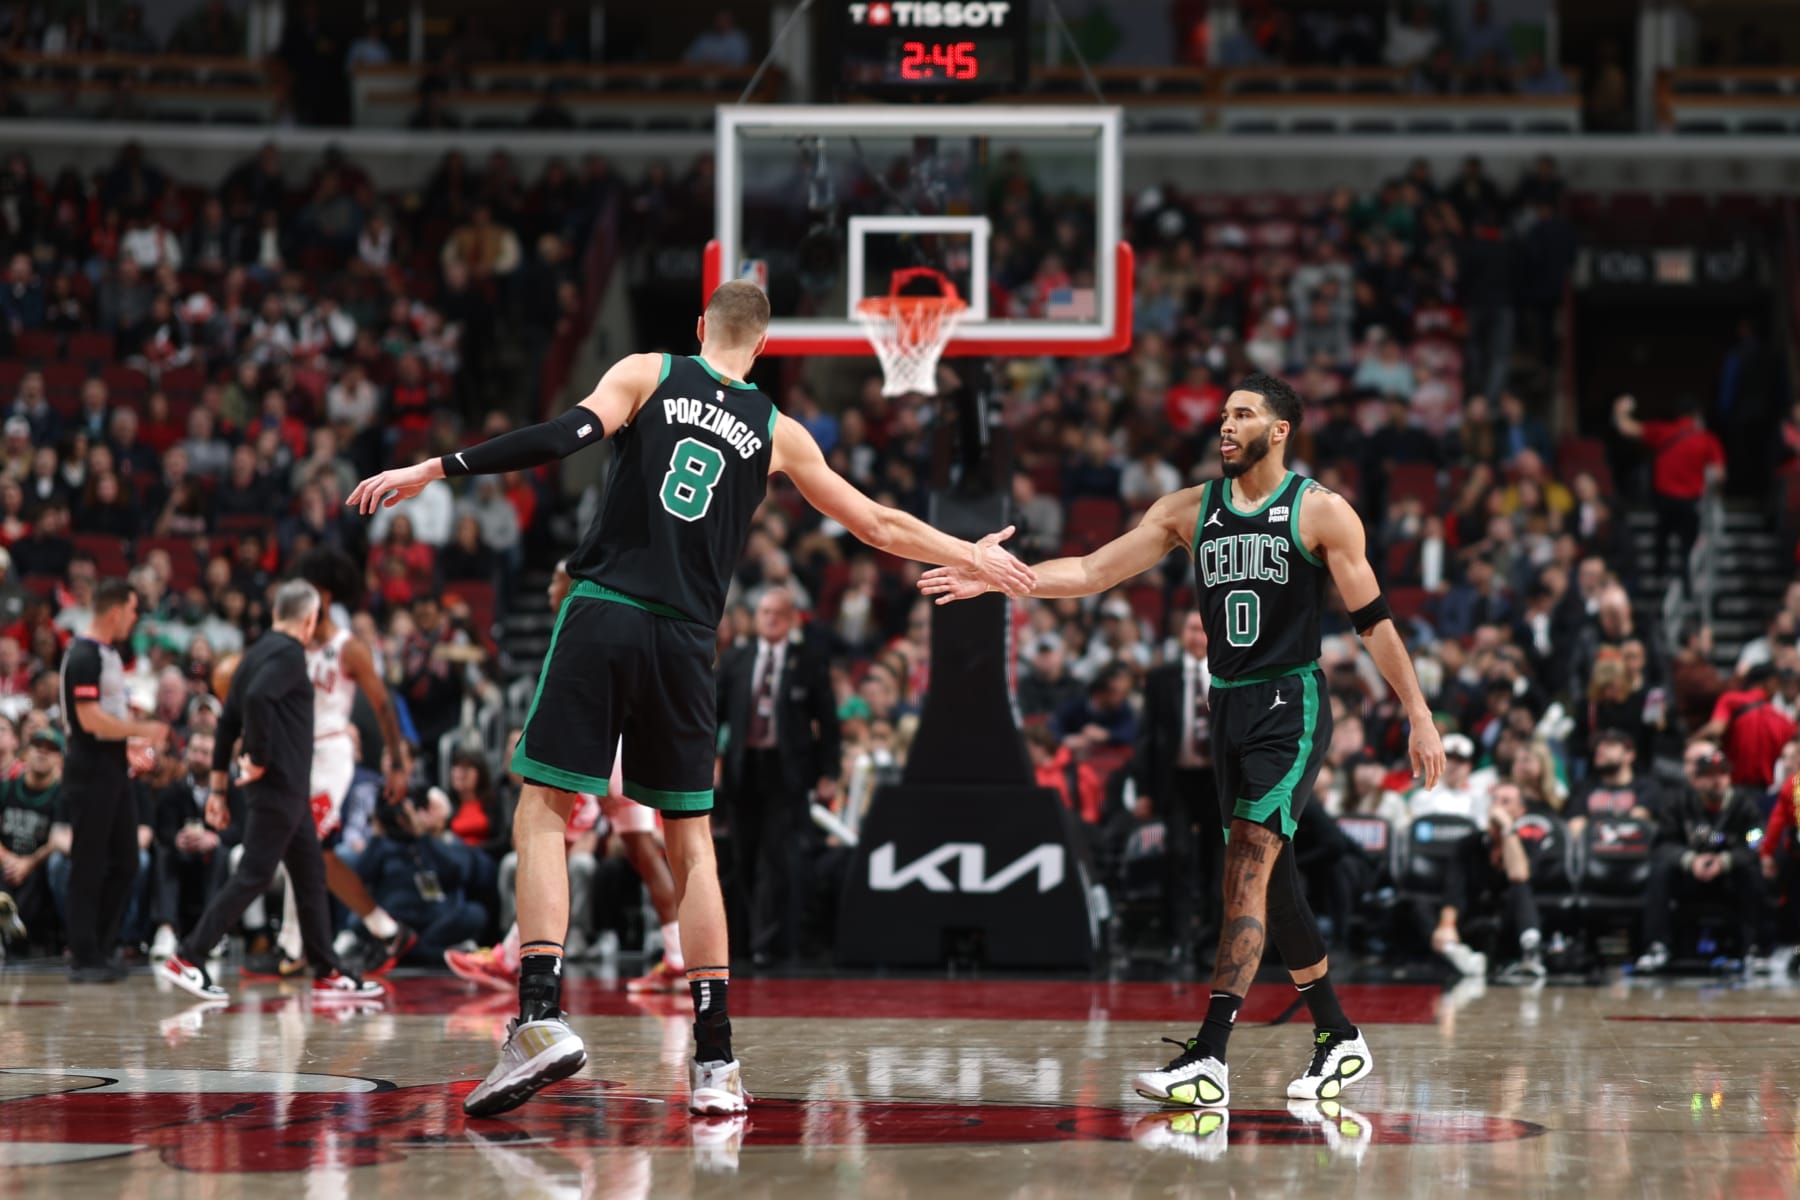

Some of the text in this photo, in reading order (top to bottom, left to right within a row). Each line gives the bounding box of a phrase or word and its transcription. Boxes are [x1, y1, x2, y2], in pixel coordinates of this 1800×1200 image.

[893, 2, 1010, 27] TISSOT
[901, 41, 978, 80] 2:45
[663, 397, 762, 459] PORZINGIS
[659, 437, 726, 522] 8
[1269, 506, 1289, 515] VISTA
[1200, 533, 1289, 588] CELTICS
[1225, 590, 1260, 647] 0
[869, 841, 1065, 893] KIA
